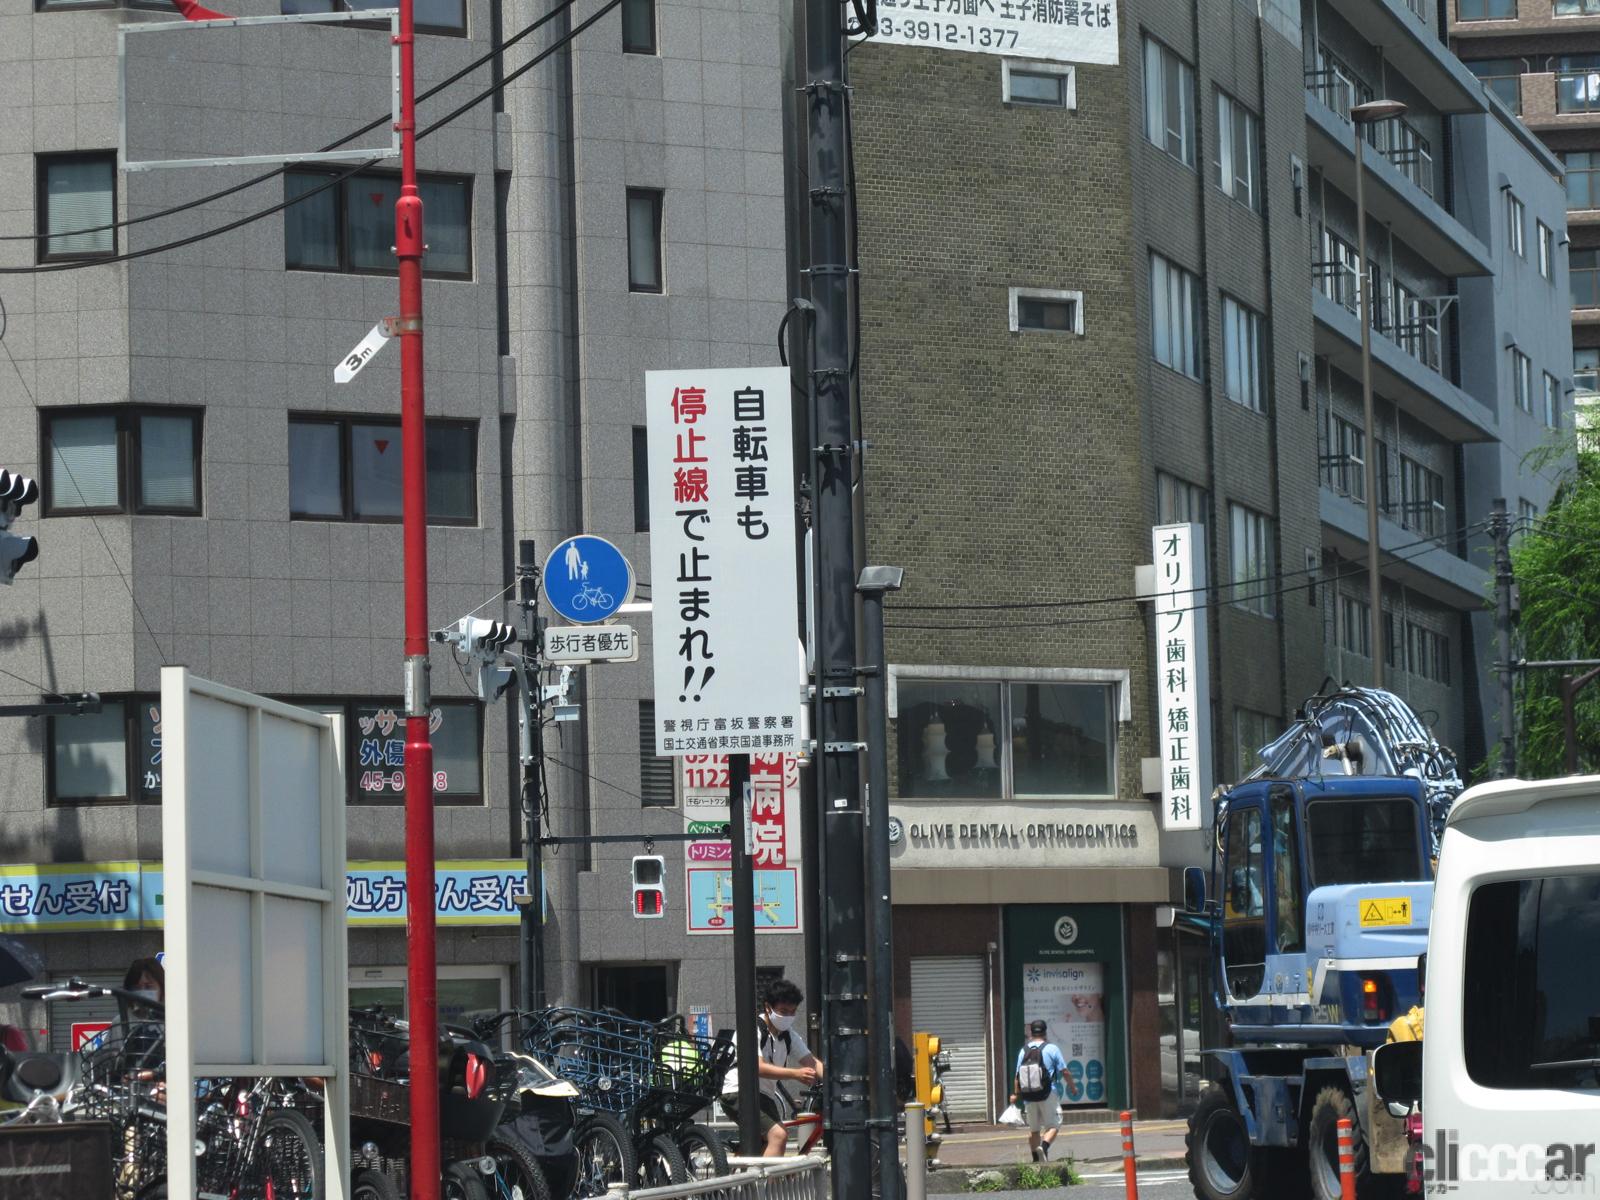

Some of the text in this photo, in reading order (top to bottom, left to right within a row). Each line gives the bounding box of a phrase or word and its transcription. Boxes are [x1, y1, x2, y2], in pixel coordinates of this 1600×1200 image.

[880, 16, 1019, 49] 3-3912-1377
[345, 347, 373, 372] 3m
[733, 386, 769, 540] 自転車も
[550, 632, 629, 653] 歩行者優先
[663, 715, 794, 733] 警視庁富坂警察署
[663, 733, 795, 751] 国土交通省東京国道事務所
[686, 769, 730, 788] 1122
[910, 824, 954, 839] OLIVE
[959, 824, 1017, 839] DENTAL
[1027, 824, 1137, 839] ORTHODONTICS
[346, 876, 530, 911] 処方ん受付
[1043, 968, 1084, 981] invisalign
